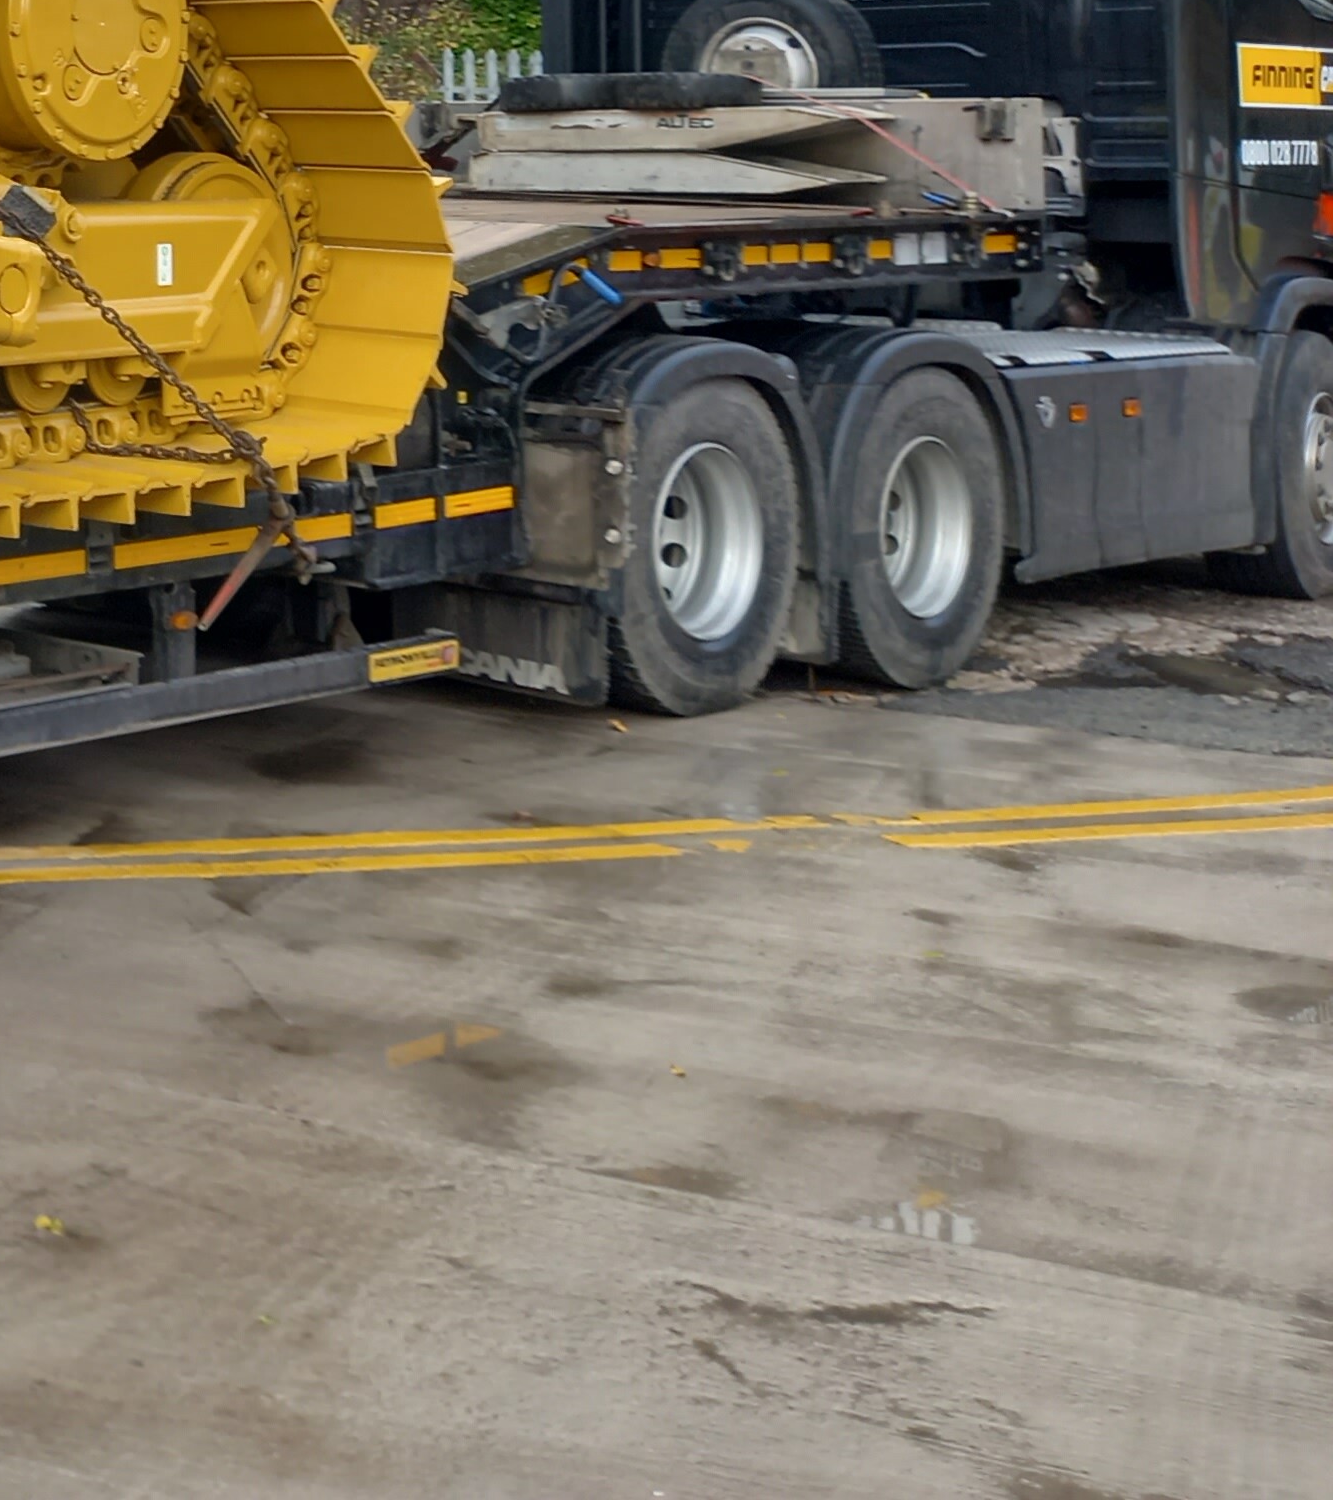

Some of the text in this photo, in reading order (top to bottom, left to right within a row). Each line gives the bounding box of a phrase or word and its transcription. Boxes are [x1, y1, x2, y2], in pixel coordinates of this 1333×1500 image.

[1252, 64, 1315, 90] FINNING
[656, 113, 715, 129] ALTEC
[459, 645, 571, 696] CANIA
